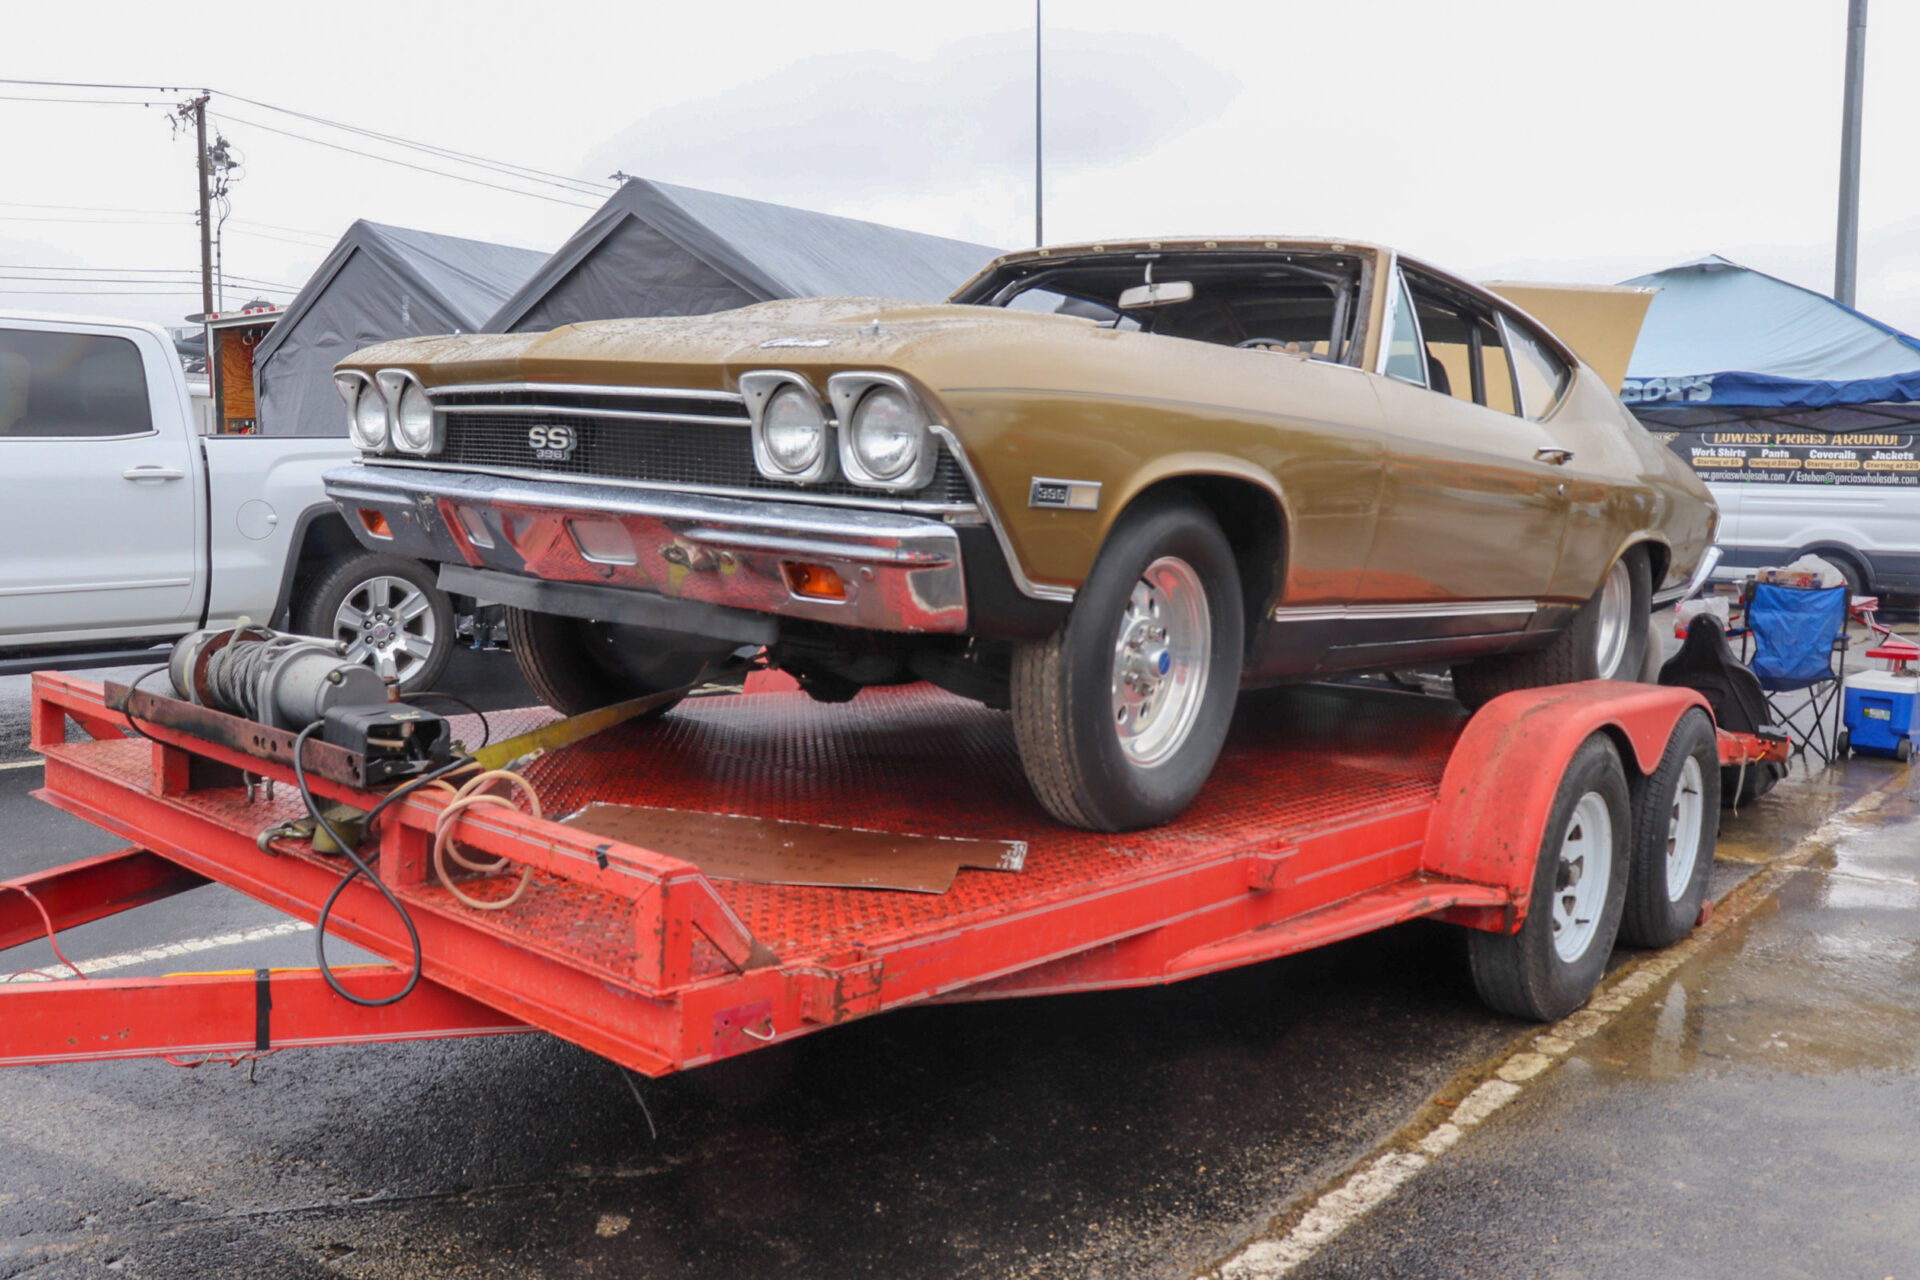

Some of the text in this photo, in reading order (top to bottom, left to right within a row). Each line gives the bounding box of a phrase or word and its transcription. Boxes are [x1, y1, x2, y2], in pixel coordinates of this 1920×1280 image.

[1619, 375, 1715, 402] BOYS
[529, 424, 574, 450] SS
[1714, 433, 1898, 446] LOWEST PRICES AROUND!
[536, 449, 564, 460] 396
[1691, 447, 1746, 457] Work Shirts
[1762, 449, 1789, 458] Pants
[1809, 449, 1856, 460] Coveralls
[1872, 450, 1914, 460] Jackets
[1807, 461, 1833, 470] Starting
[1866, 462, 1894, 470] Starting
[1696, 469, 1785, 481] ww.garciaswholesale.com
[1797, 471, 1918, 485] Esteban@garciaswholesale.com
[1038, 487, 1065, 500] 396
